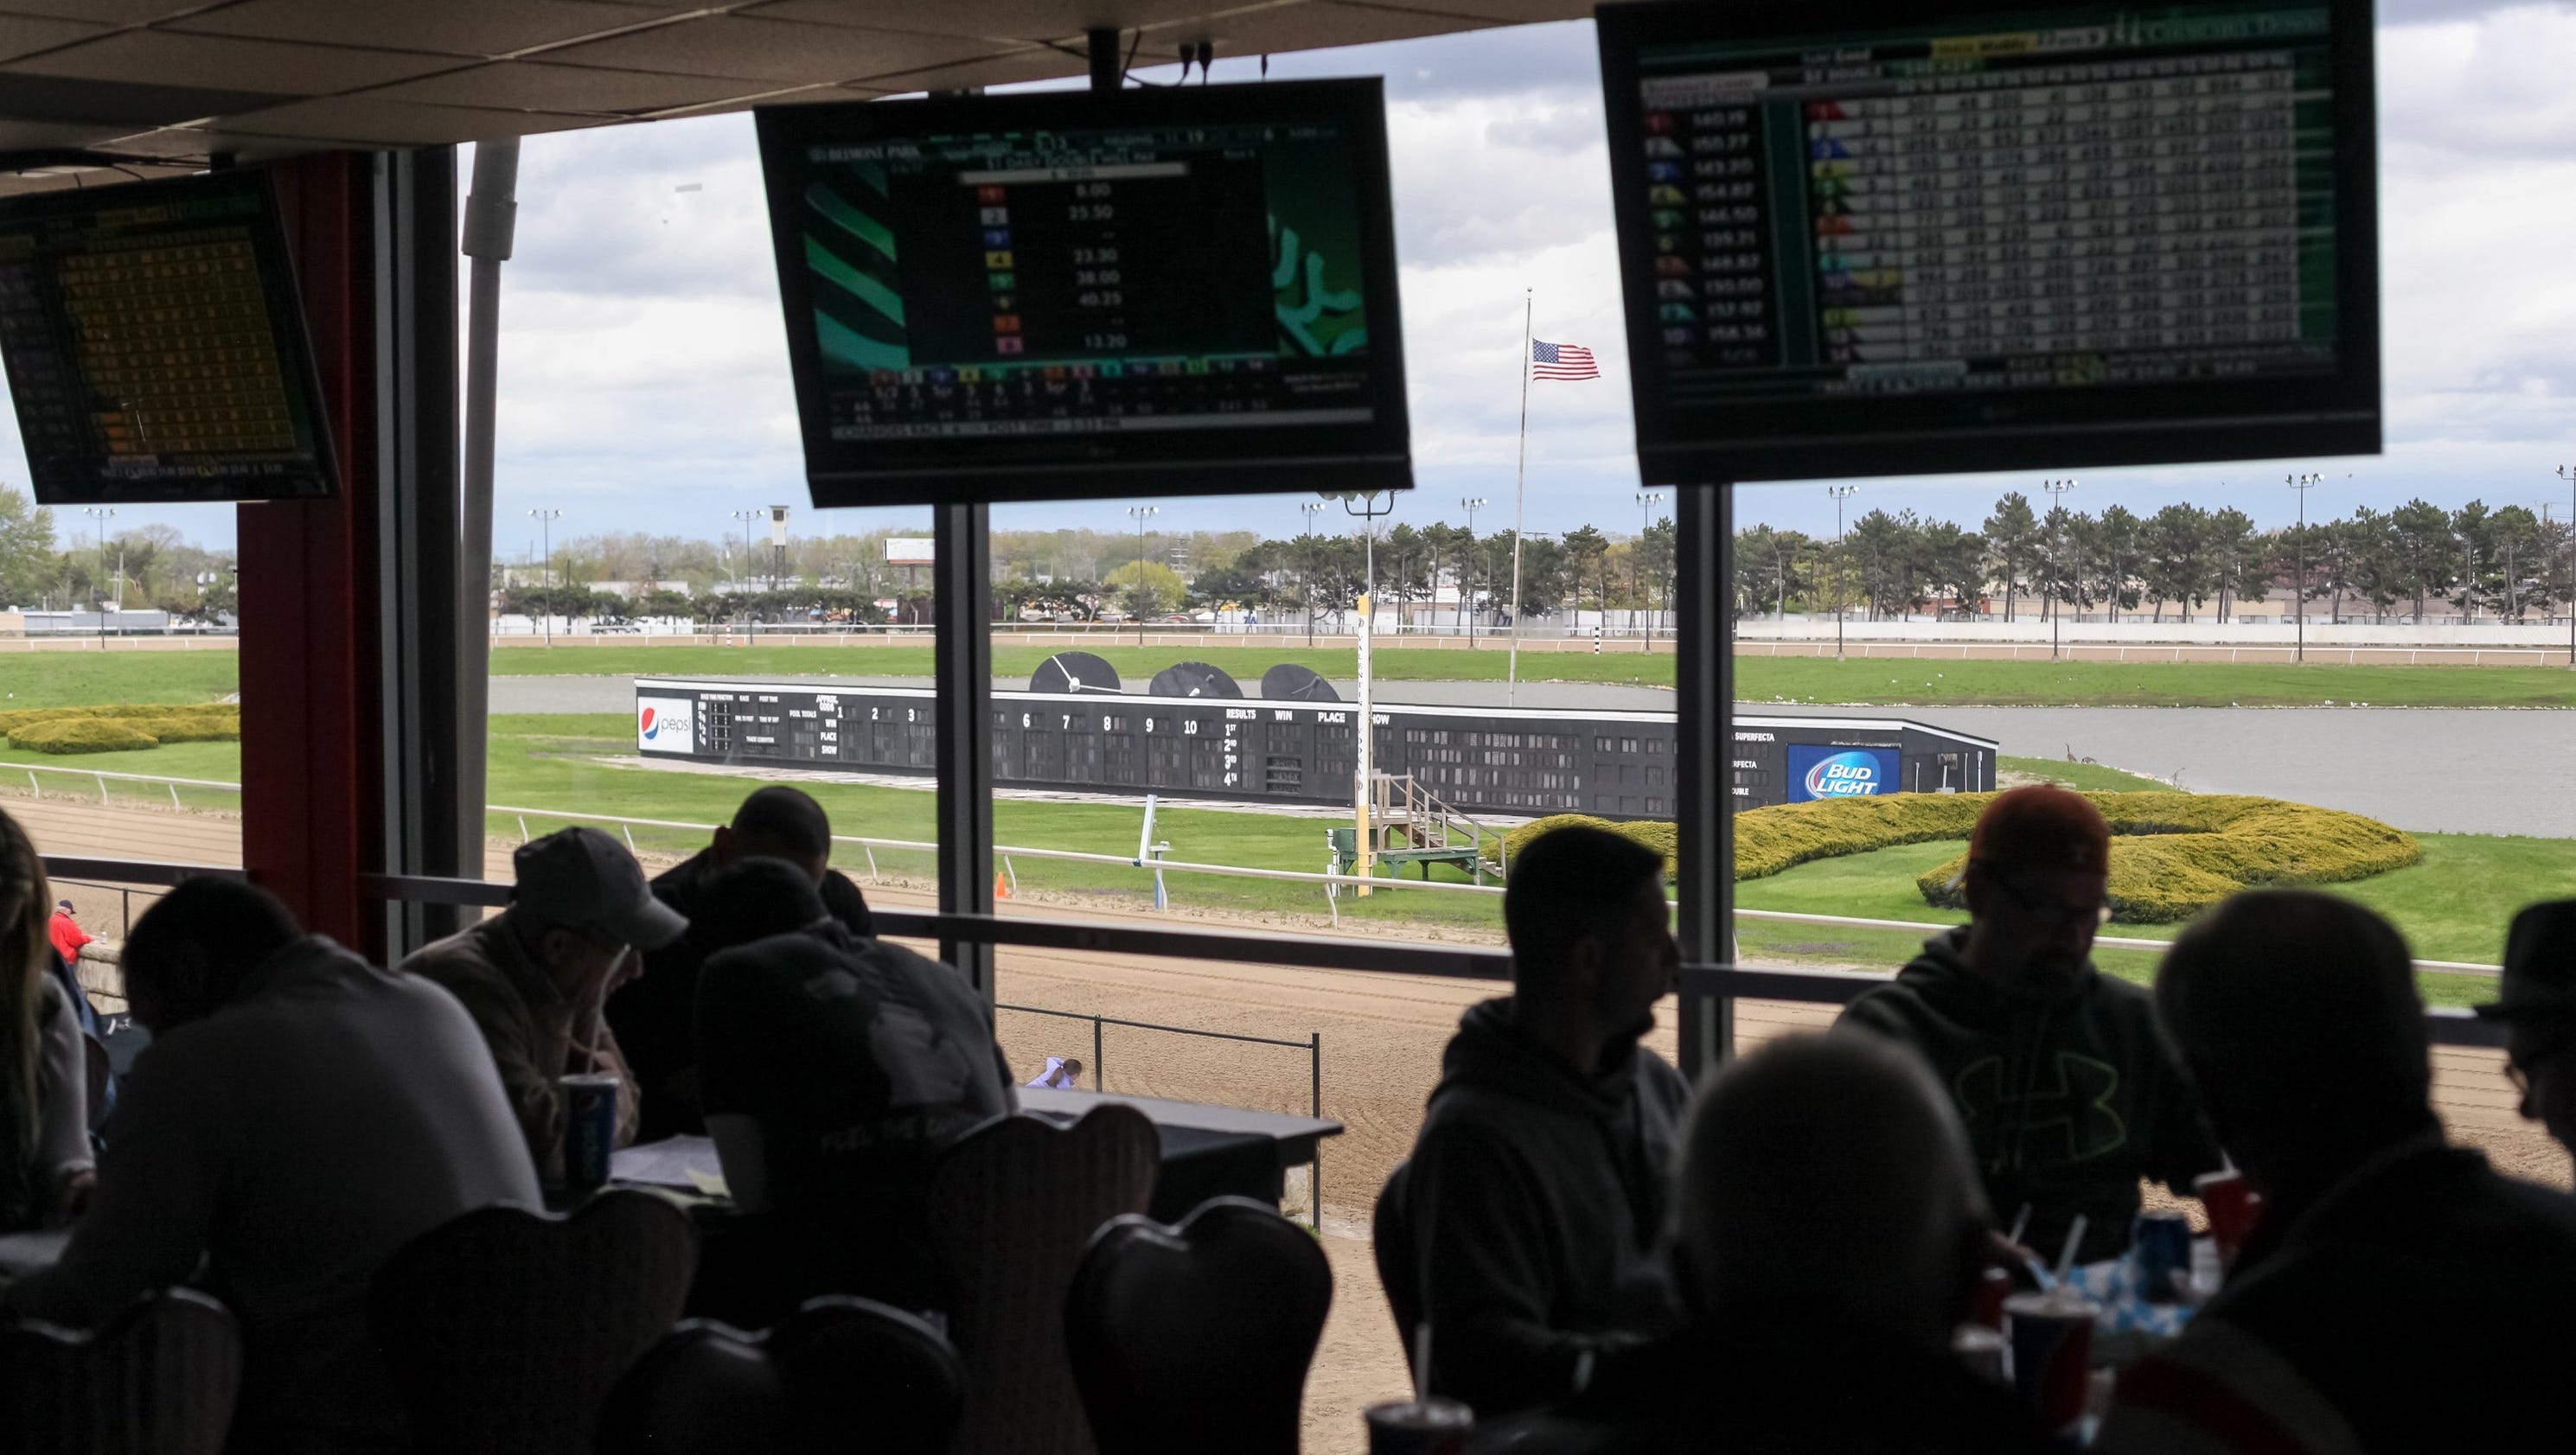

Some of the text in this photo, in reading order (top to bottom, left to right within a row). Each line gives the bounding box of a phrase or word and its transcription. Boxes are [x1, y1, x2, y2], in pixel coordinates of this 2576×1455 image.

[825, 719, 837, 728] WIN
[837, 706, 1198, 734] 1 2 3 6 7 8 9 10
[1226, 709, 1390, 724] RESULTS WIN PLACE HOW
[661, 717, 691, 733] pepsi
[821, 732, 837, 741] PLACE
[1735, 732, 1775, 742] SUPERFECTA
[821, 745, 837, 755] SHOW
[1826, 763, 1872, 780] BUD
[1816, 778, 1878, 795] LIGHT
